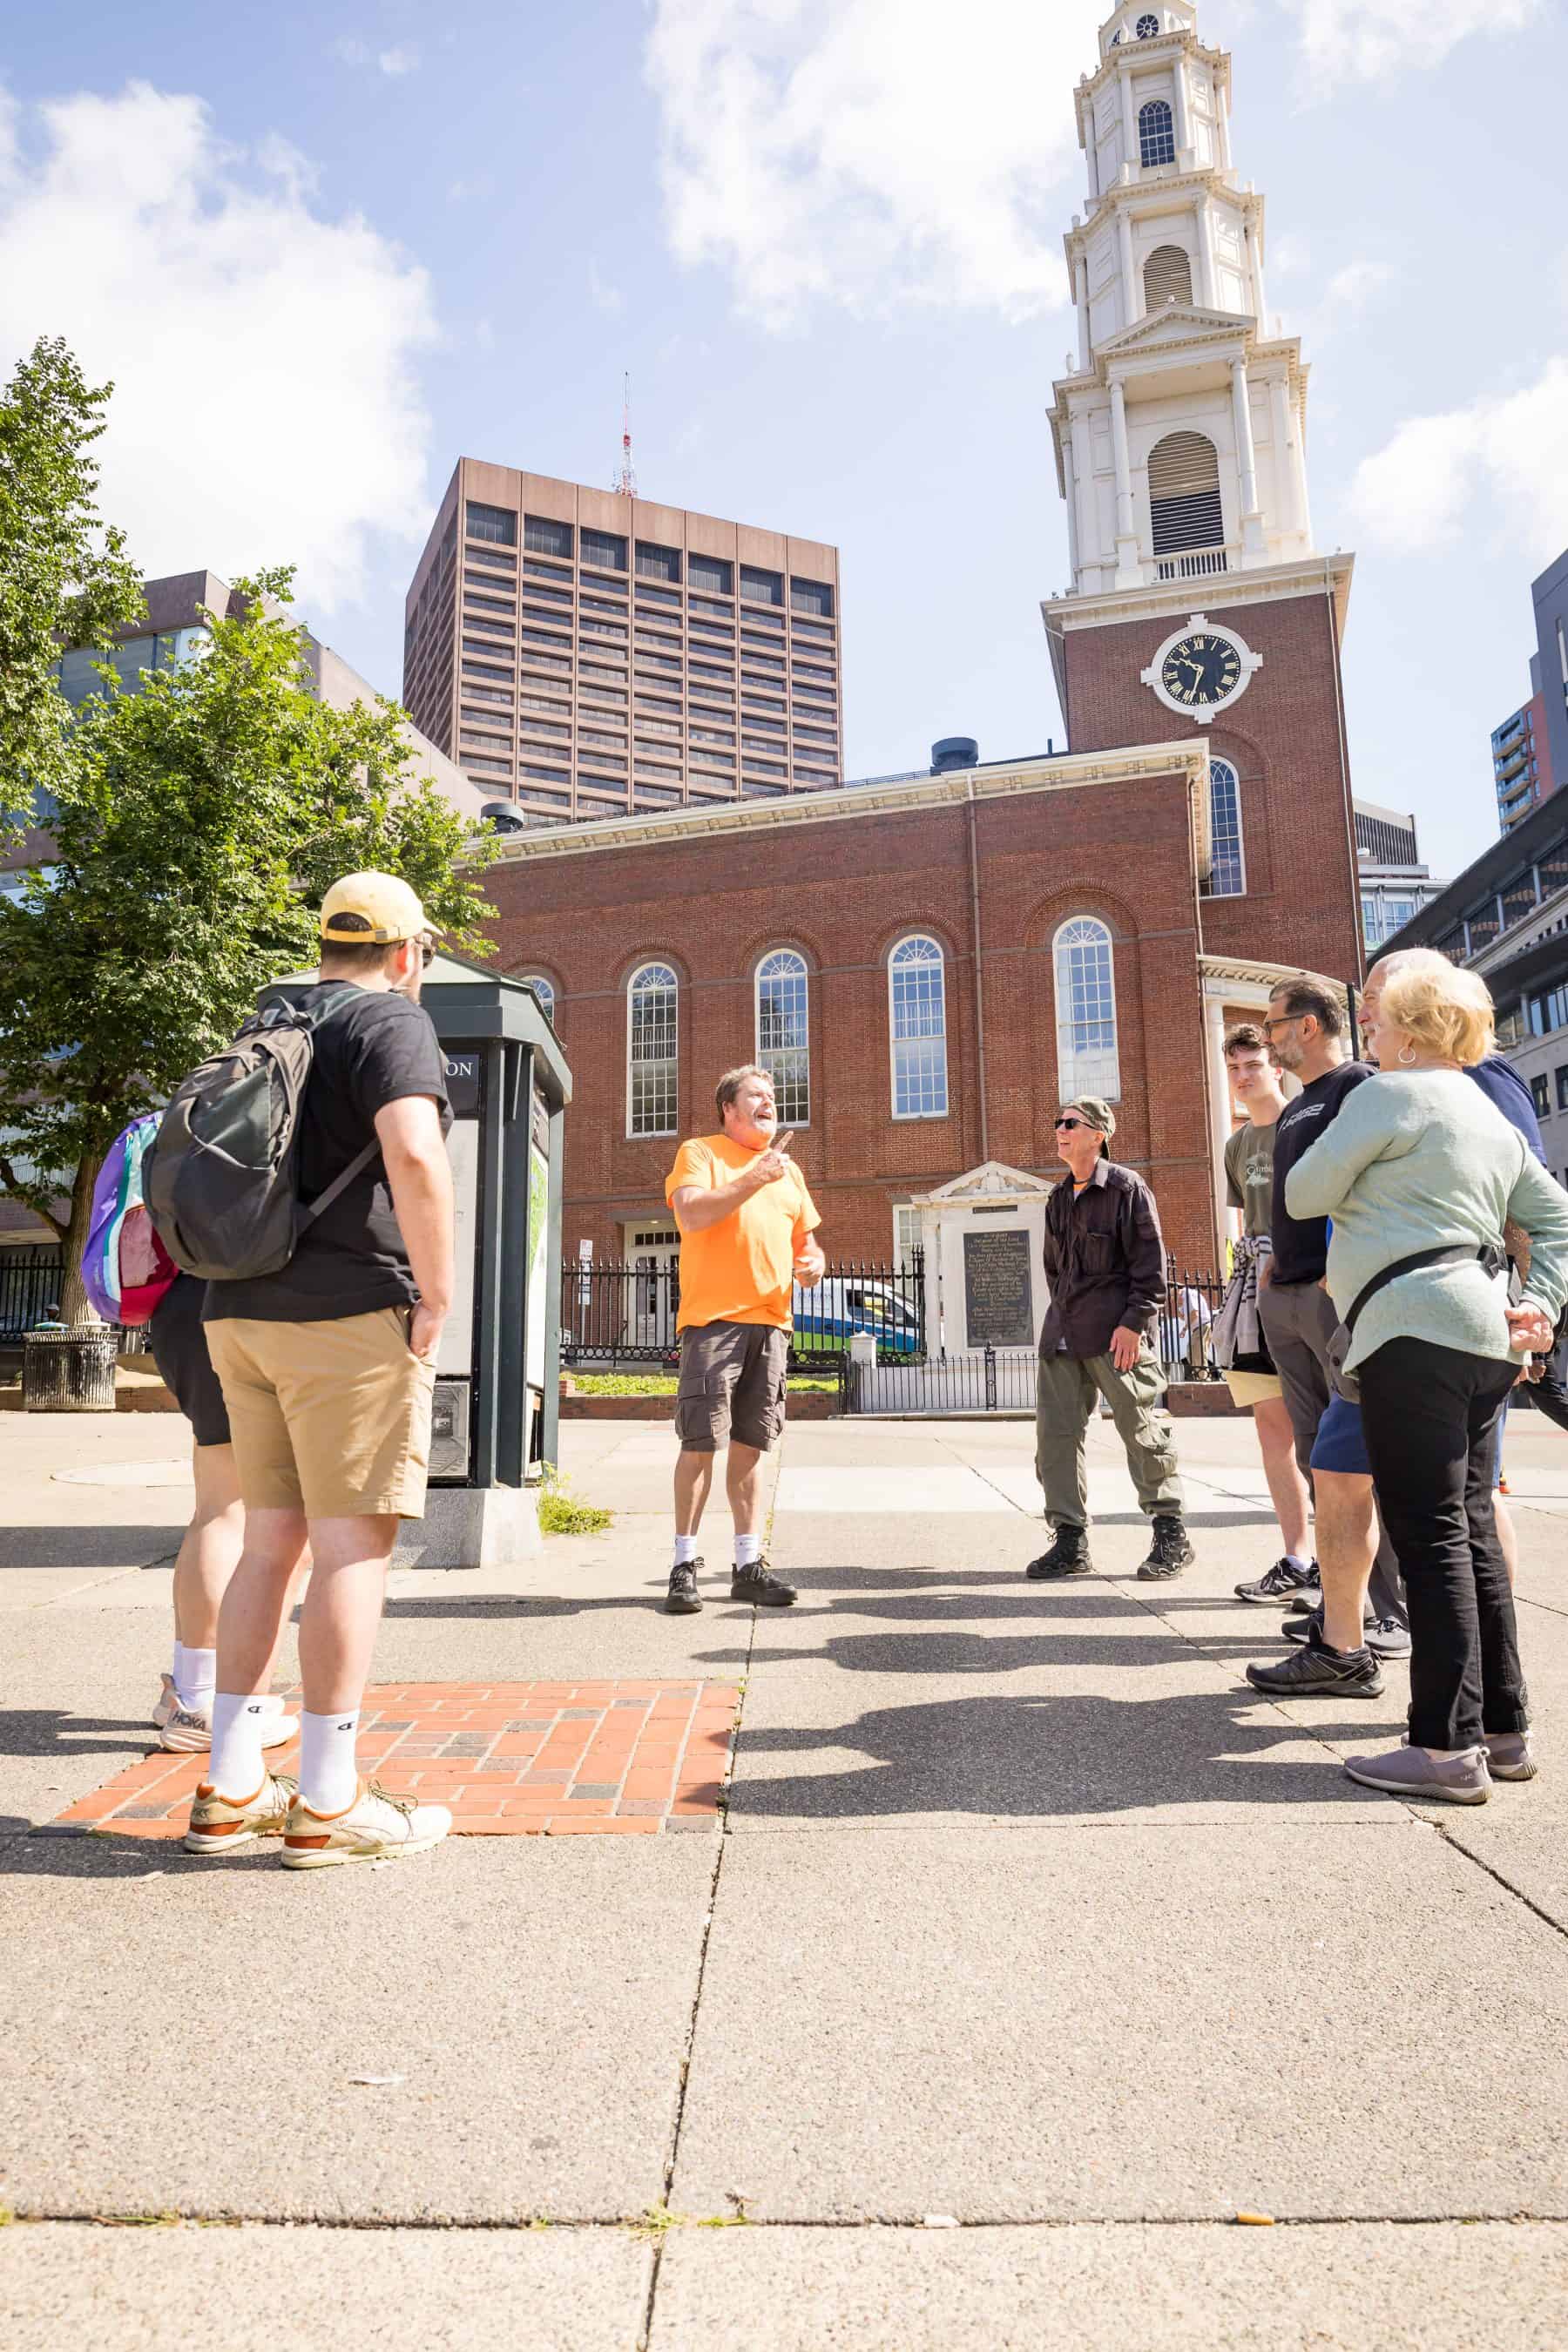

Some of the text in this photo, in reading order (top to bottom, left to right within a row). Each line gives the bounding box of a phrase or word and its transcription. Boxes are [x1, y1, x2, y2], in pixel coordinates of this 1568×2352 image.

[1193, 639, 1205, 651] XII
[1210, 639, 1218, 651] I
[172, 1710, 206, 1731] HOKA
